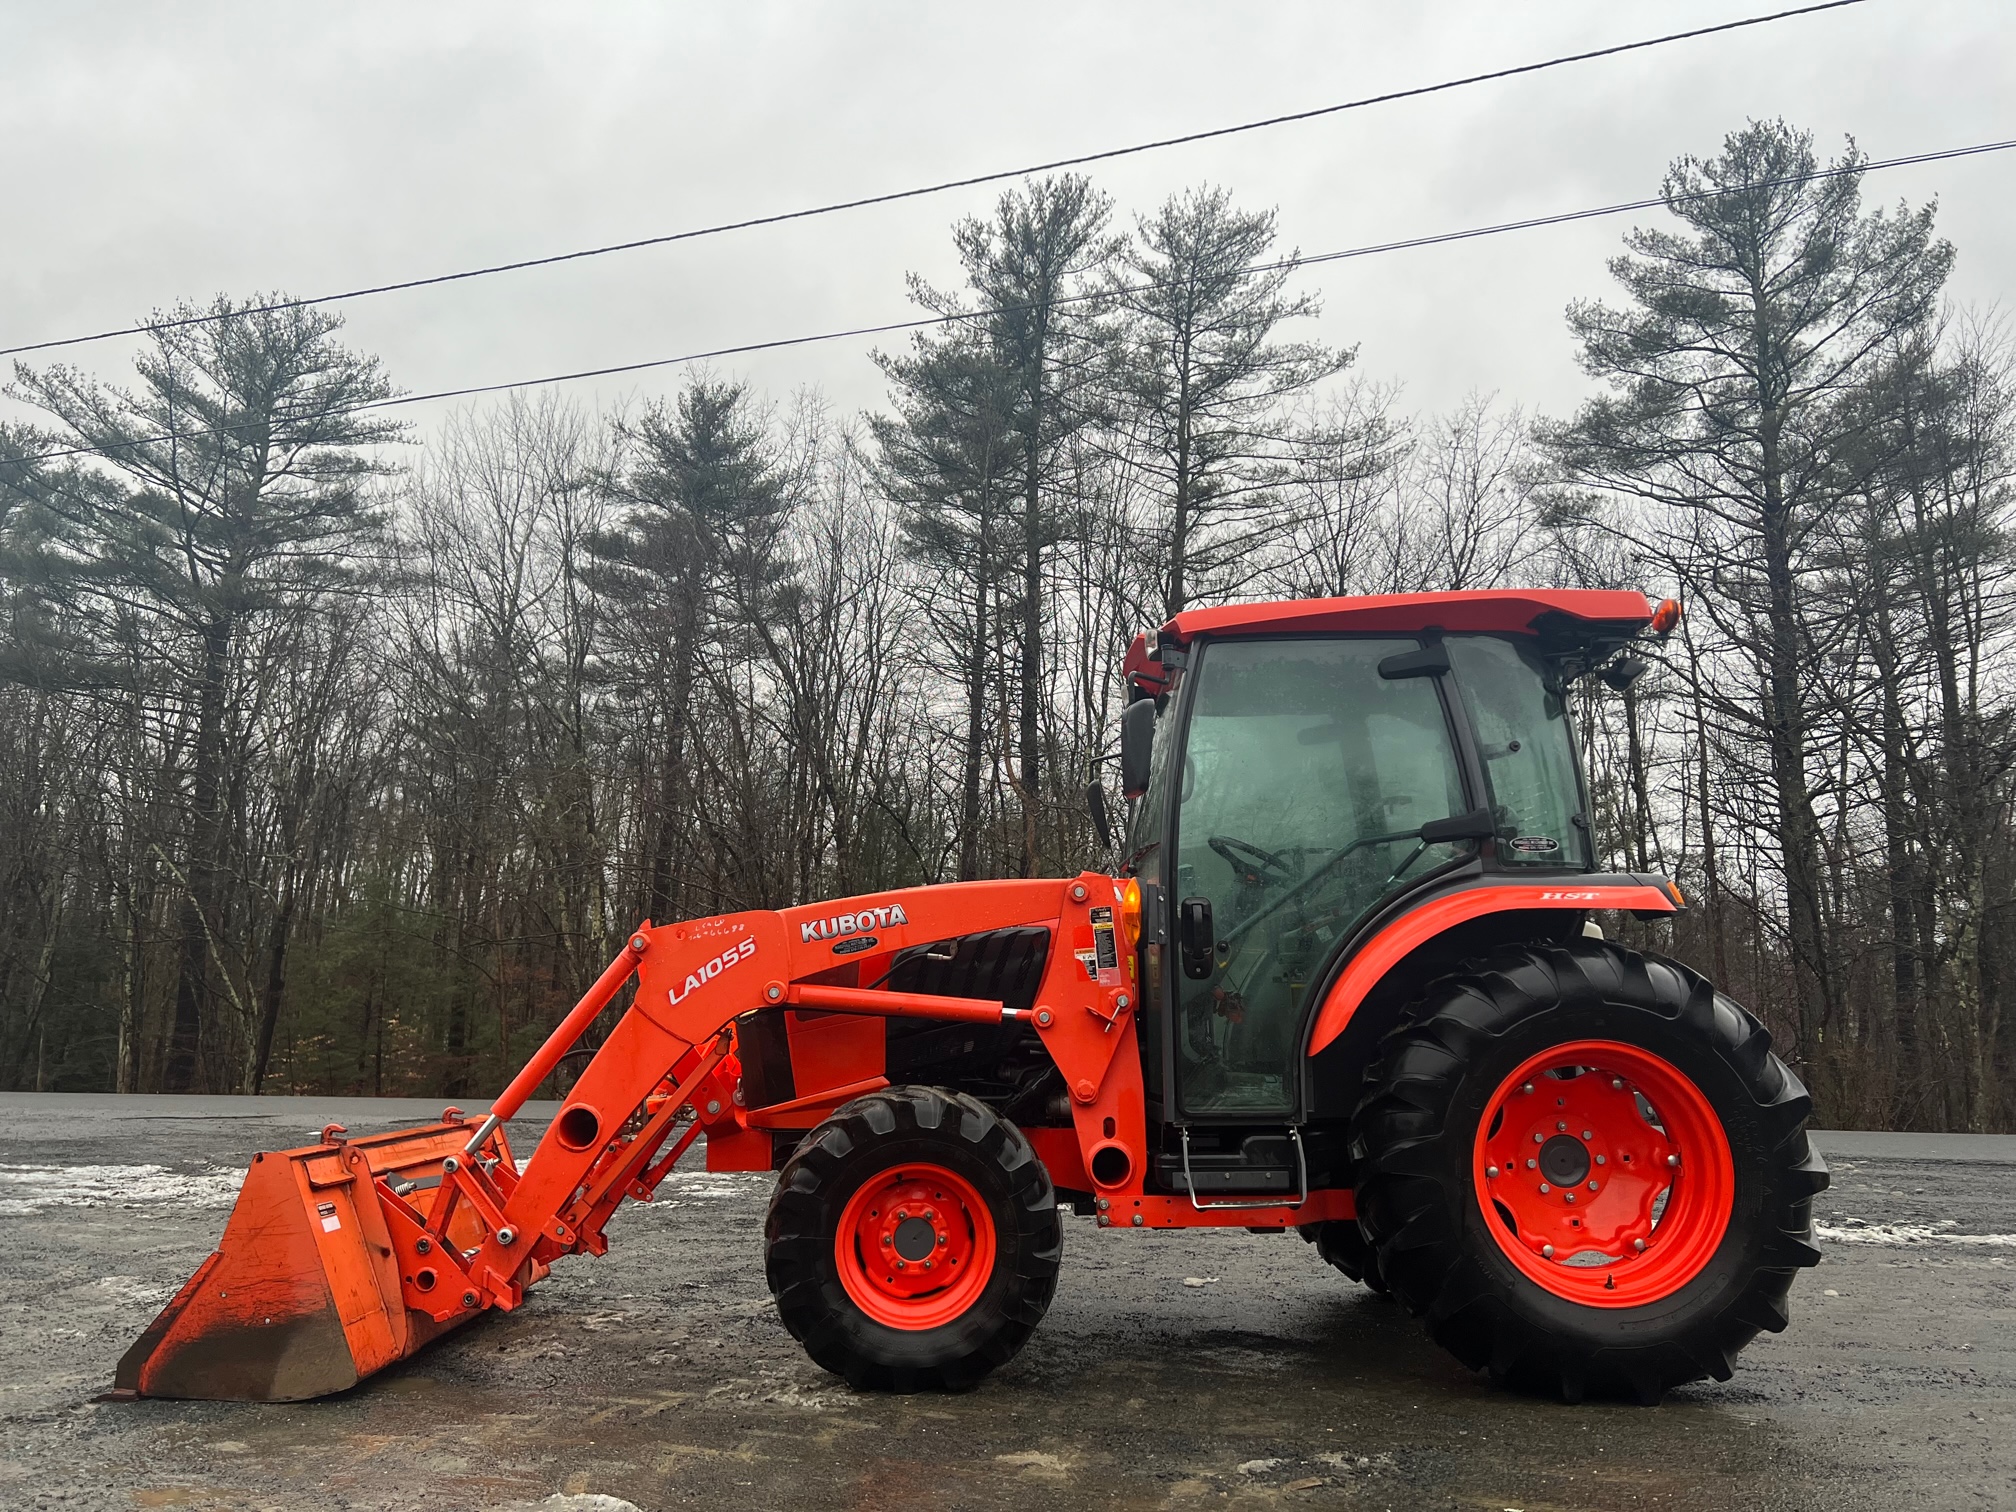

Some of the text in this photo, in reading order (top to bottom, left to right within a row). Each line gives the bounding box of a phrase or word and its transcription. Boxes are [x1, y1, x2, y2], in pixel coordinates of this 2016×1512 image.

[1540, 892, 1599, 900] HST
[800, 903, 908, 944] KUBOTA
[668, 935, 757, 1006] LA1055
